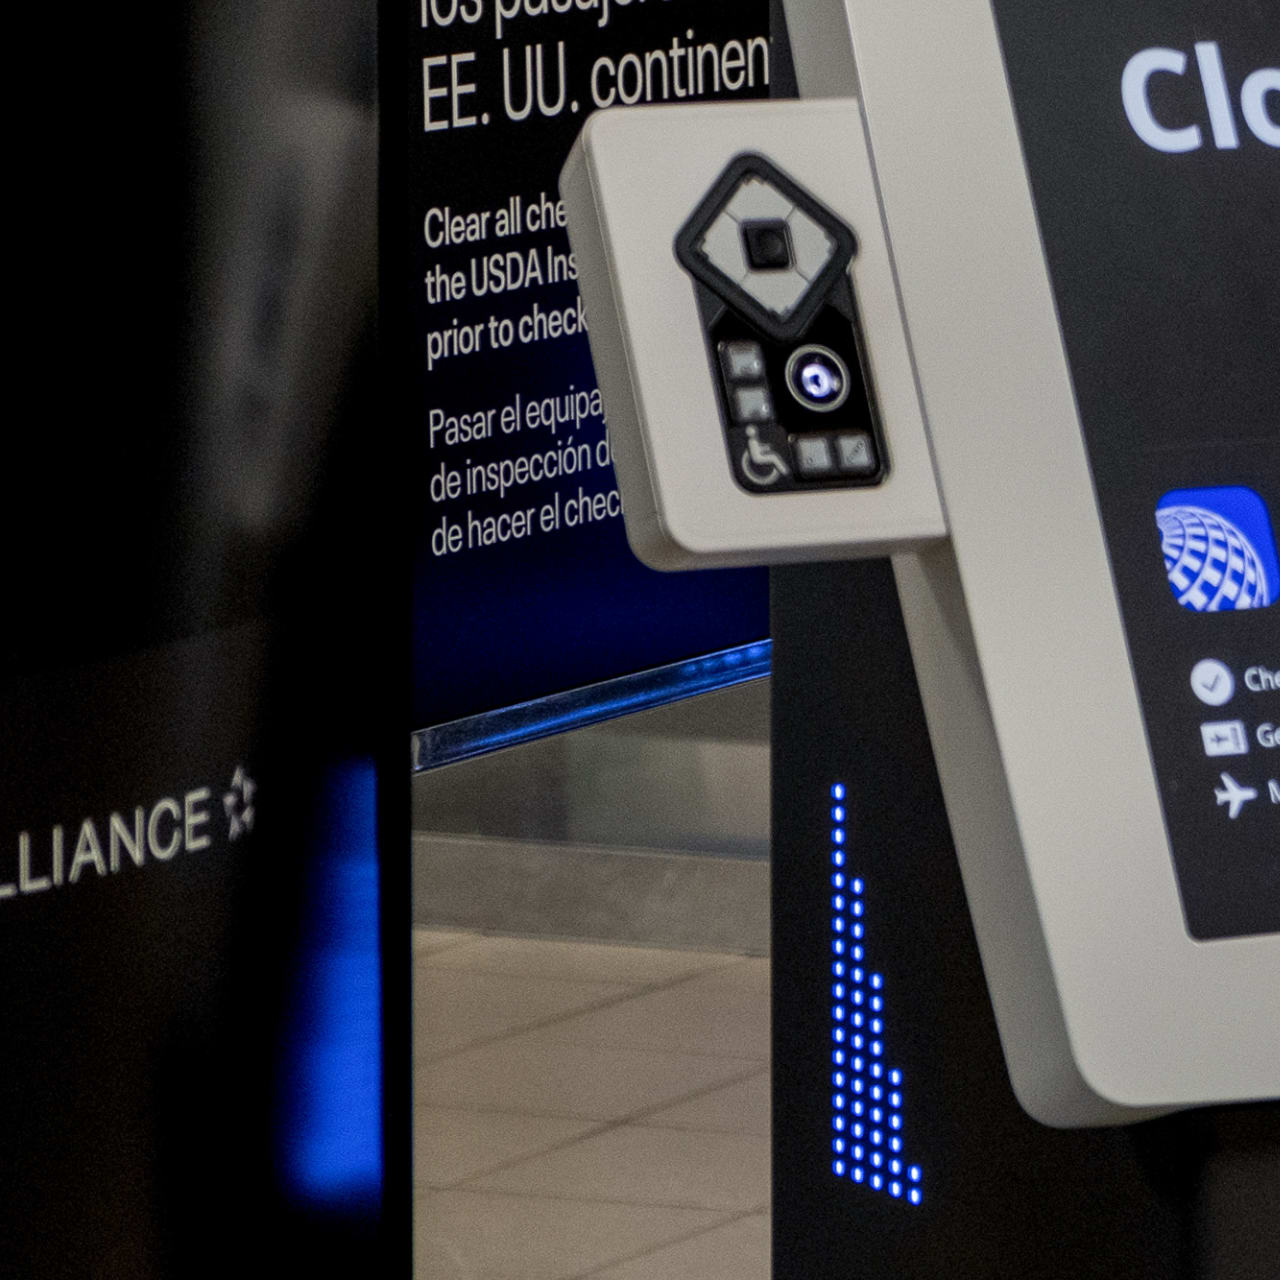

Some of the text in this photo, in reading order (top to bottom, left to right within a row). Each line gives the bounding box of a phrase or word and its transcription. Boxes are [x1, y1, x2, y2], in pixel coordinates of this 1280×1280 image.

[422, 51, 490, 133] EE.
[502, 40, 579, 122] UU.
[423, 206, 491, 249] Clear
[494, 195, 522, 238] all
[424, 263, 467, 305] the
[470, 247, 544, 297] USDA
[426, 317, 485, 372] prior
[487, 315, 515, 349] to
[429, 408, 497, 449] Pasar
[500, 393, 522, 434] el
[430, 461, 462, 503] de
[465, 435, 592, 499] inspección
[431, 515, 464, 557] de
[467, 507, 536, 549] hacer
[539, 491, 561, 533] el
